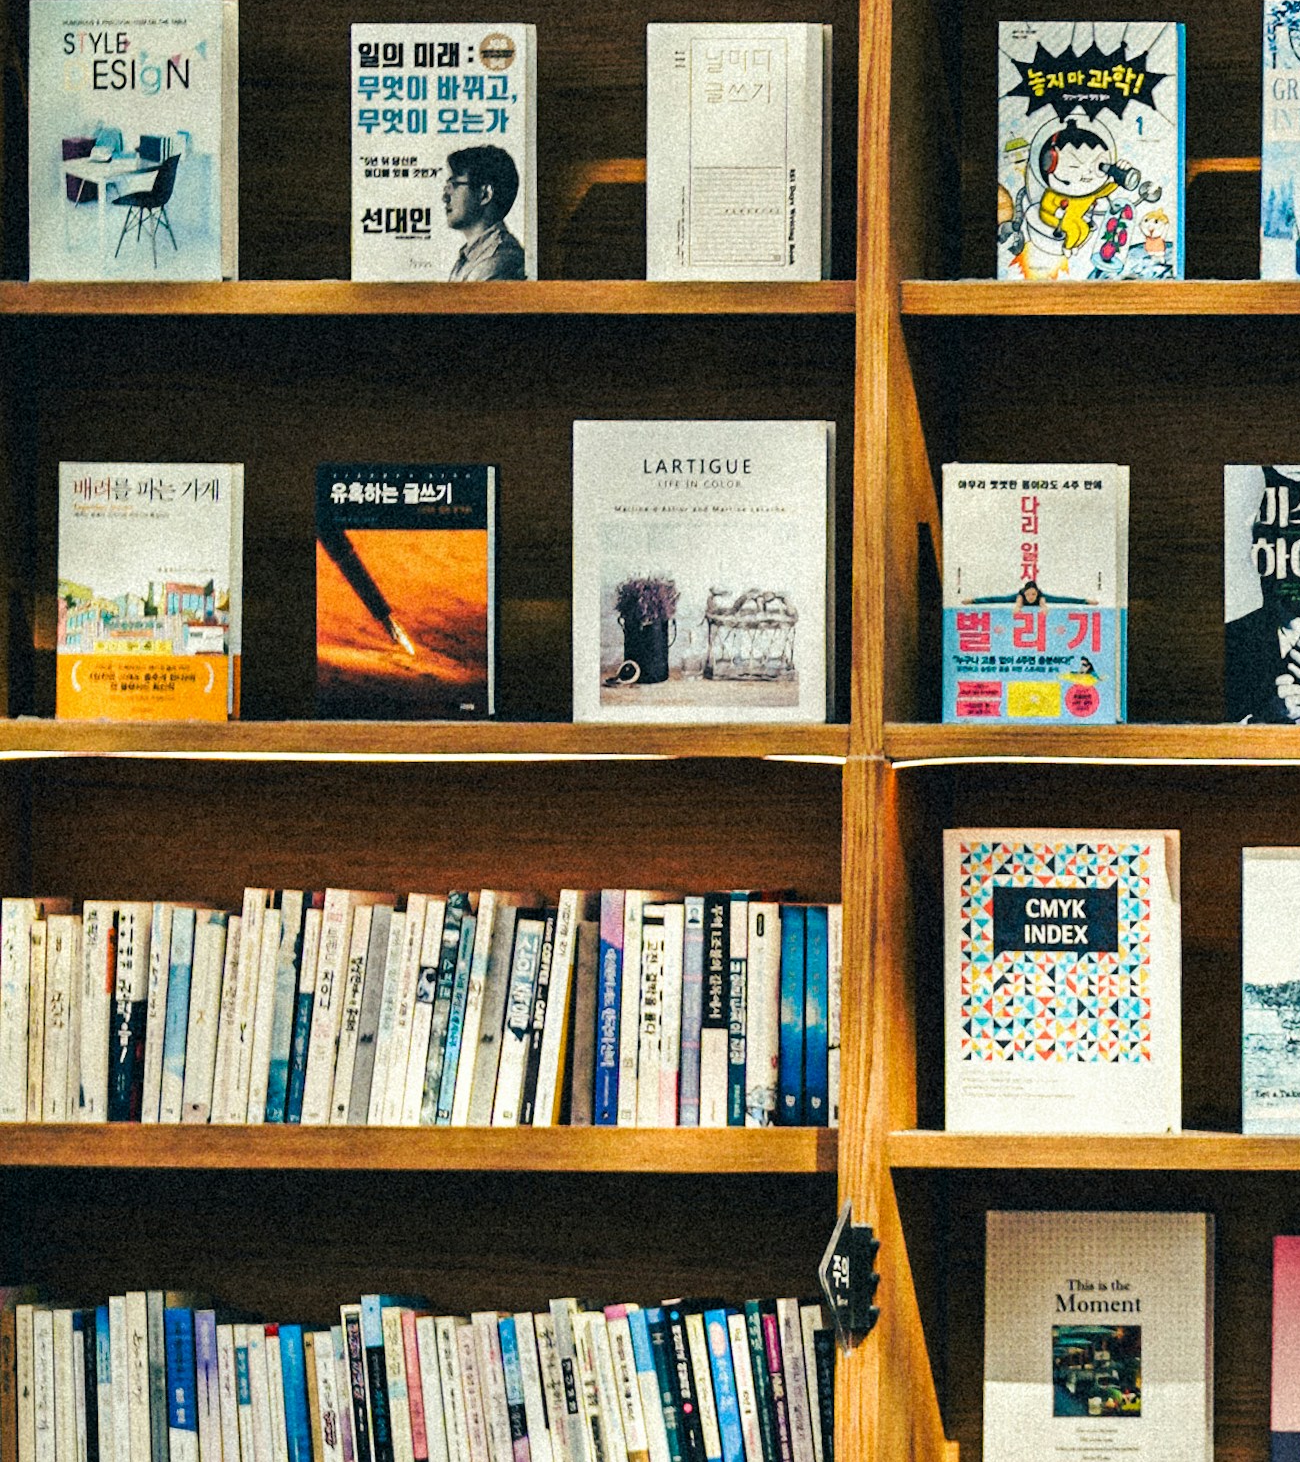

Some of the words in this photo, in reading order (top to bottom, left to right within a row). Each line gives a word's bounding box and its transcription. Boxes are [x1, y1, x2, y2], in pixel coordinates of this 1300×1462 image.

[358, 43, 404, 68] 일의
[414, 42, 460, 68] 미래
[358, 75, 428, 101] 무엇이
[437, 75, 517, 102] 바뀌고,
[358, 108, 427, 134] 무엇이
[438, 108, 509, 134] 오는가
[361, 209, 431, 235] 선대인
[644, 458, 752, 476] LARTIGUE
[331, 482, 398, 504] 유혹하는
[403, 483, 452, 504] 글쓰기
[1025, 898, 1085, 918] CMYK
[1024, 924, 1088, 944] INDEX
[1068, 1279, 1095, 1291] This
[1097, 1282, 1108, 1291] is
[1111, 1279, 1130, 1291] the
[1056, 1295, 1141, 1314] Moment
